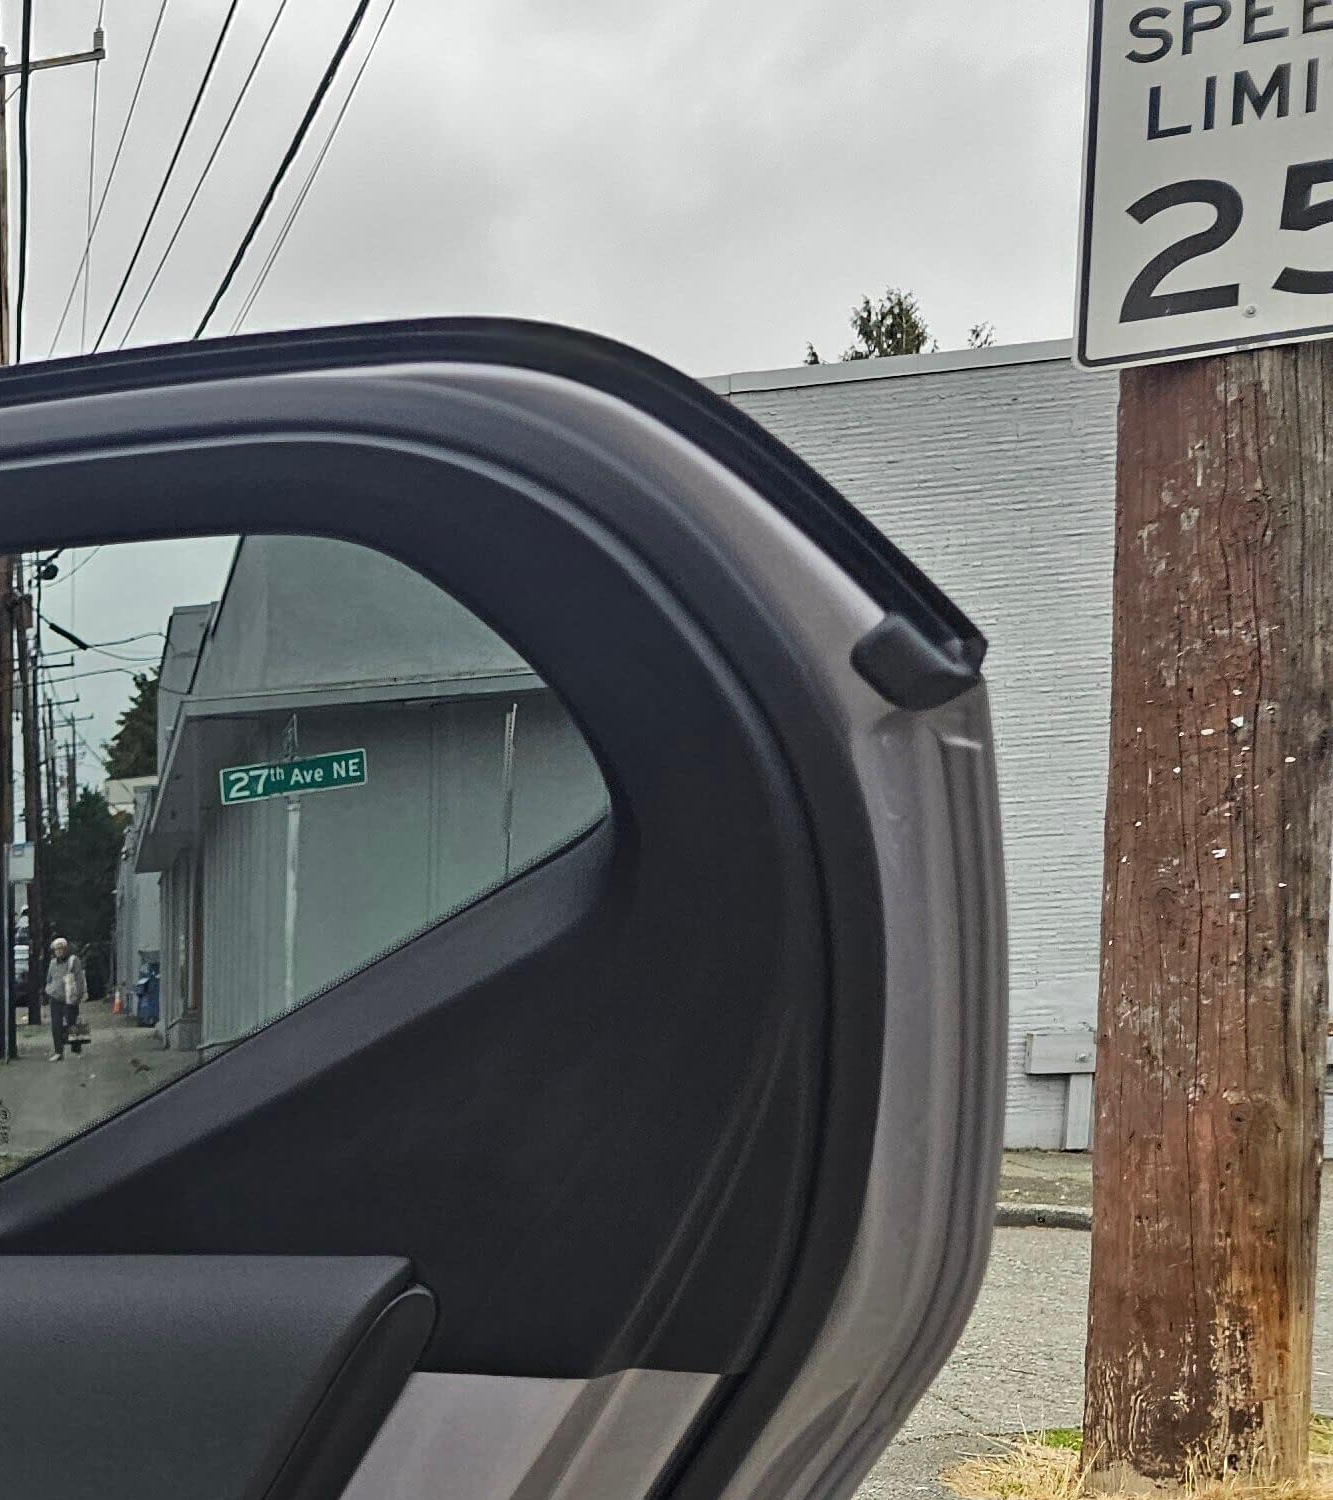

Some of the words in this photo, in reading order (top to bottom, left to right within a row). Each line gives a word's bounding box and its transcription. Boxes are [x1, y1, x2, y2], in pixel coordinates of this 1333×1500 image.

[1125, 0, 1333, 63] SPEE
[1147, 57, 1319, 140] LIMI
[228, 766, 285, 799] 27th
[289, 767, 324, 786] Ave
[333, 758, 361, 779] NE
